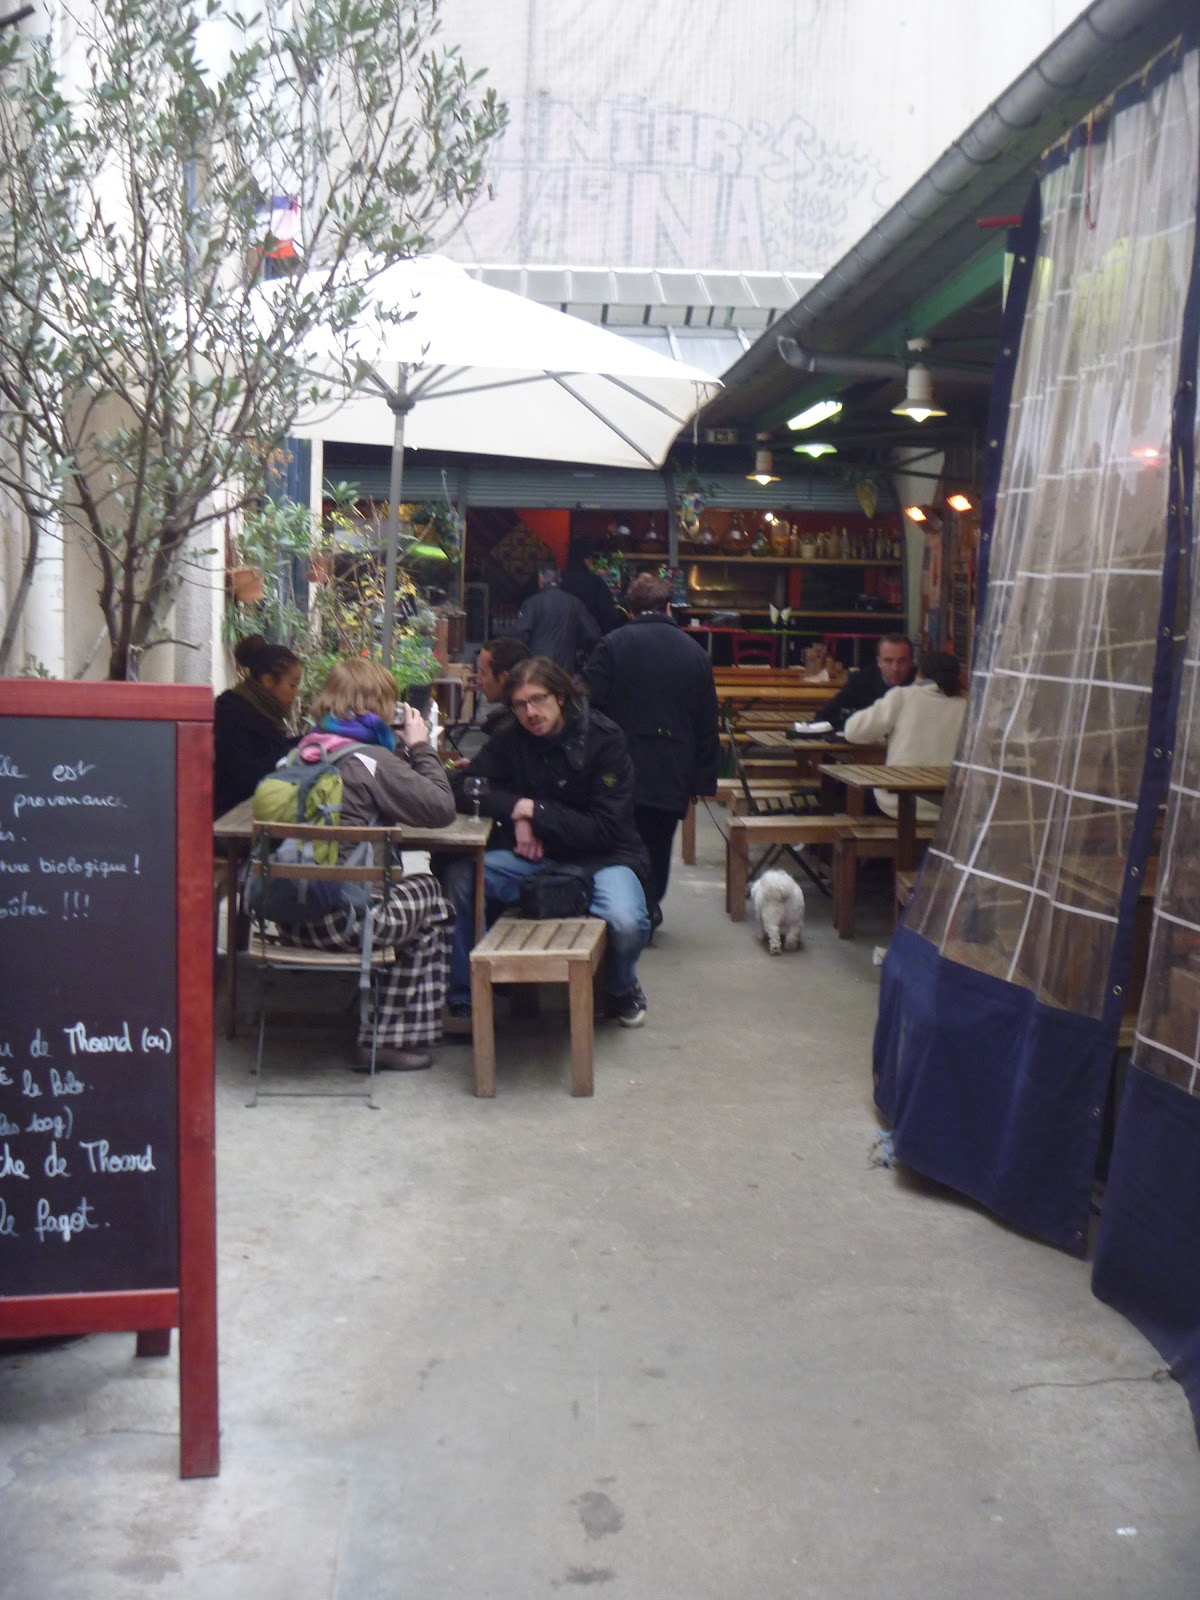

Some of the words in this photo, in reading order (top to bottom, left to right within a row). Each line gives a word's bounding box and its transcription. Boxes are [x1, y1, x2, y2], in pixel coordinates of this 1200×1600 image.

[53, 760, 96, 782] est
[63, 891, 90, 920] !!!
[30, 1028, 53, 1058] de
[22, 1069, 43, 1098] le
[44, 1140, 71, 1177] de
[79, 1139, 156, 1172] Thoard
